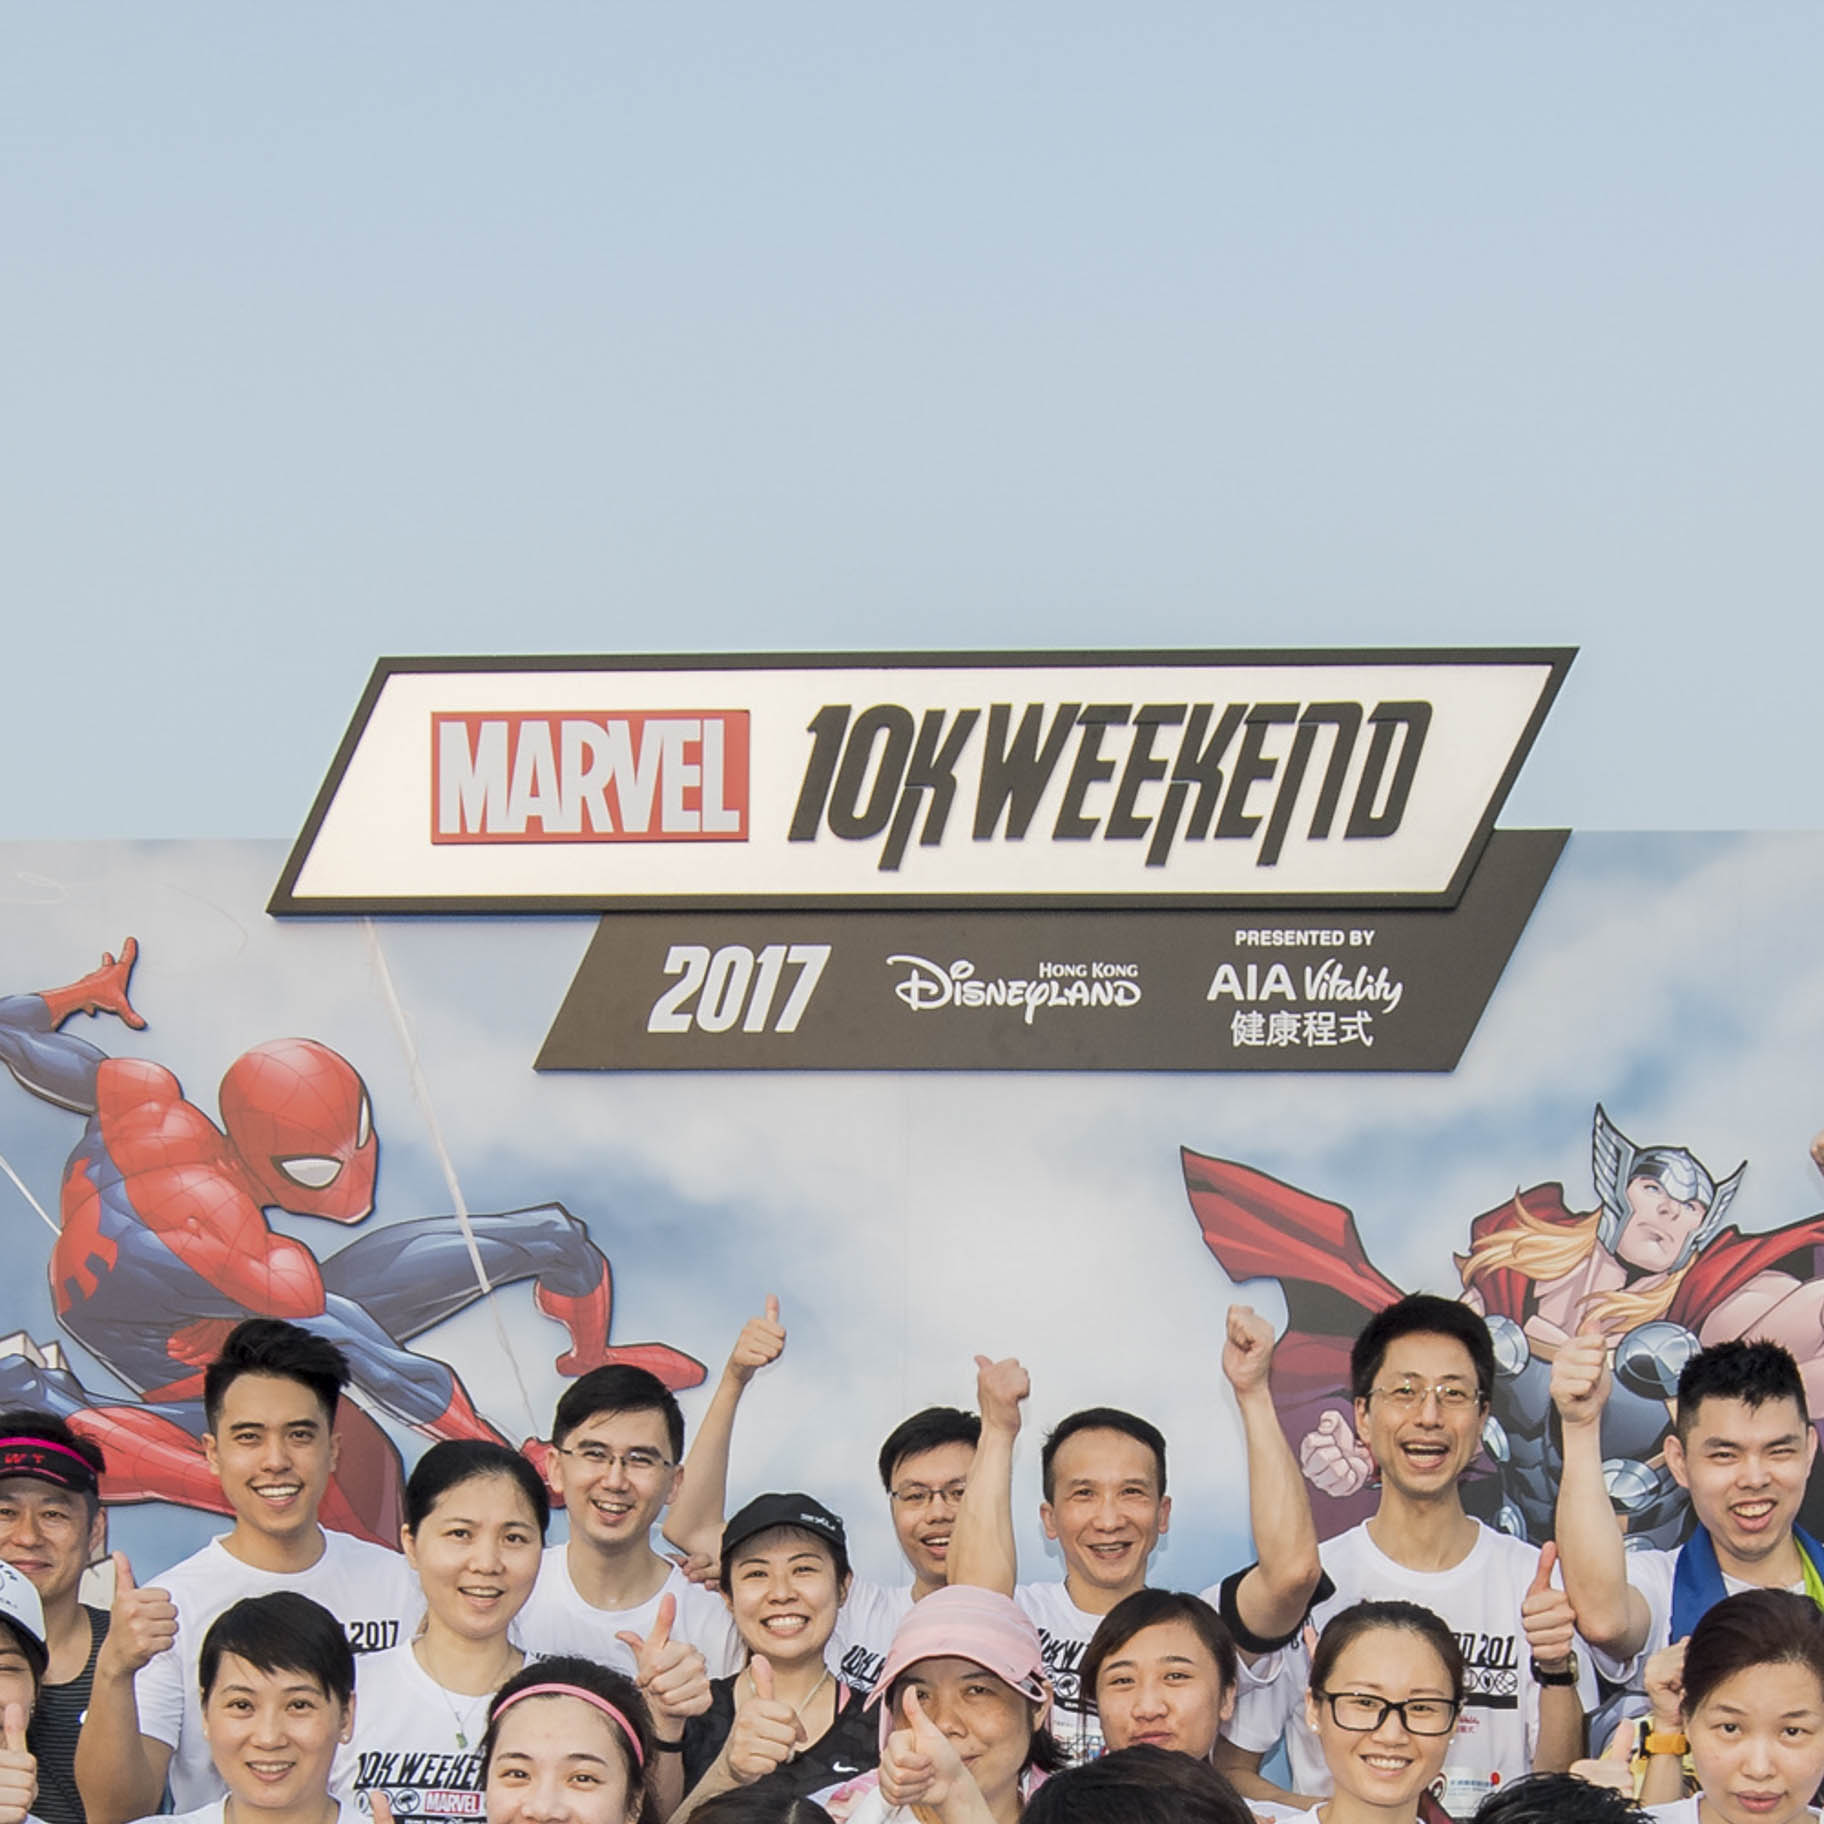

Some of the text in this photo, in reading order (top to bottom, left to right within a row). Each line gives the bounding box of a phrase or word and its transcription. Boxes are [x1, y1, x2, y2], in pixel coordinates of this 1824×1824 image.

[436, 720, 742, 836] MARVEL
[1234, 929, 1376, 947] PRESENTED BY
[1038, 961, 1140, 979] HONG KONG
[1206, 959, 1404, 1014] AIA Vitality
[647, 945, 833, 1034] 2017
[1229, 1010, 1375, 1048] 健康程式
[349, 1620, 400, 1650] 2017
[1476, 1633, 1519, 1670] 201
[353, 1752, 400, 1790] 10K
[427, 1793, 480, 1813] MARVEL
